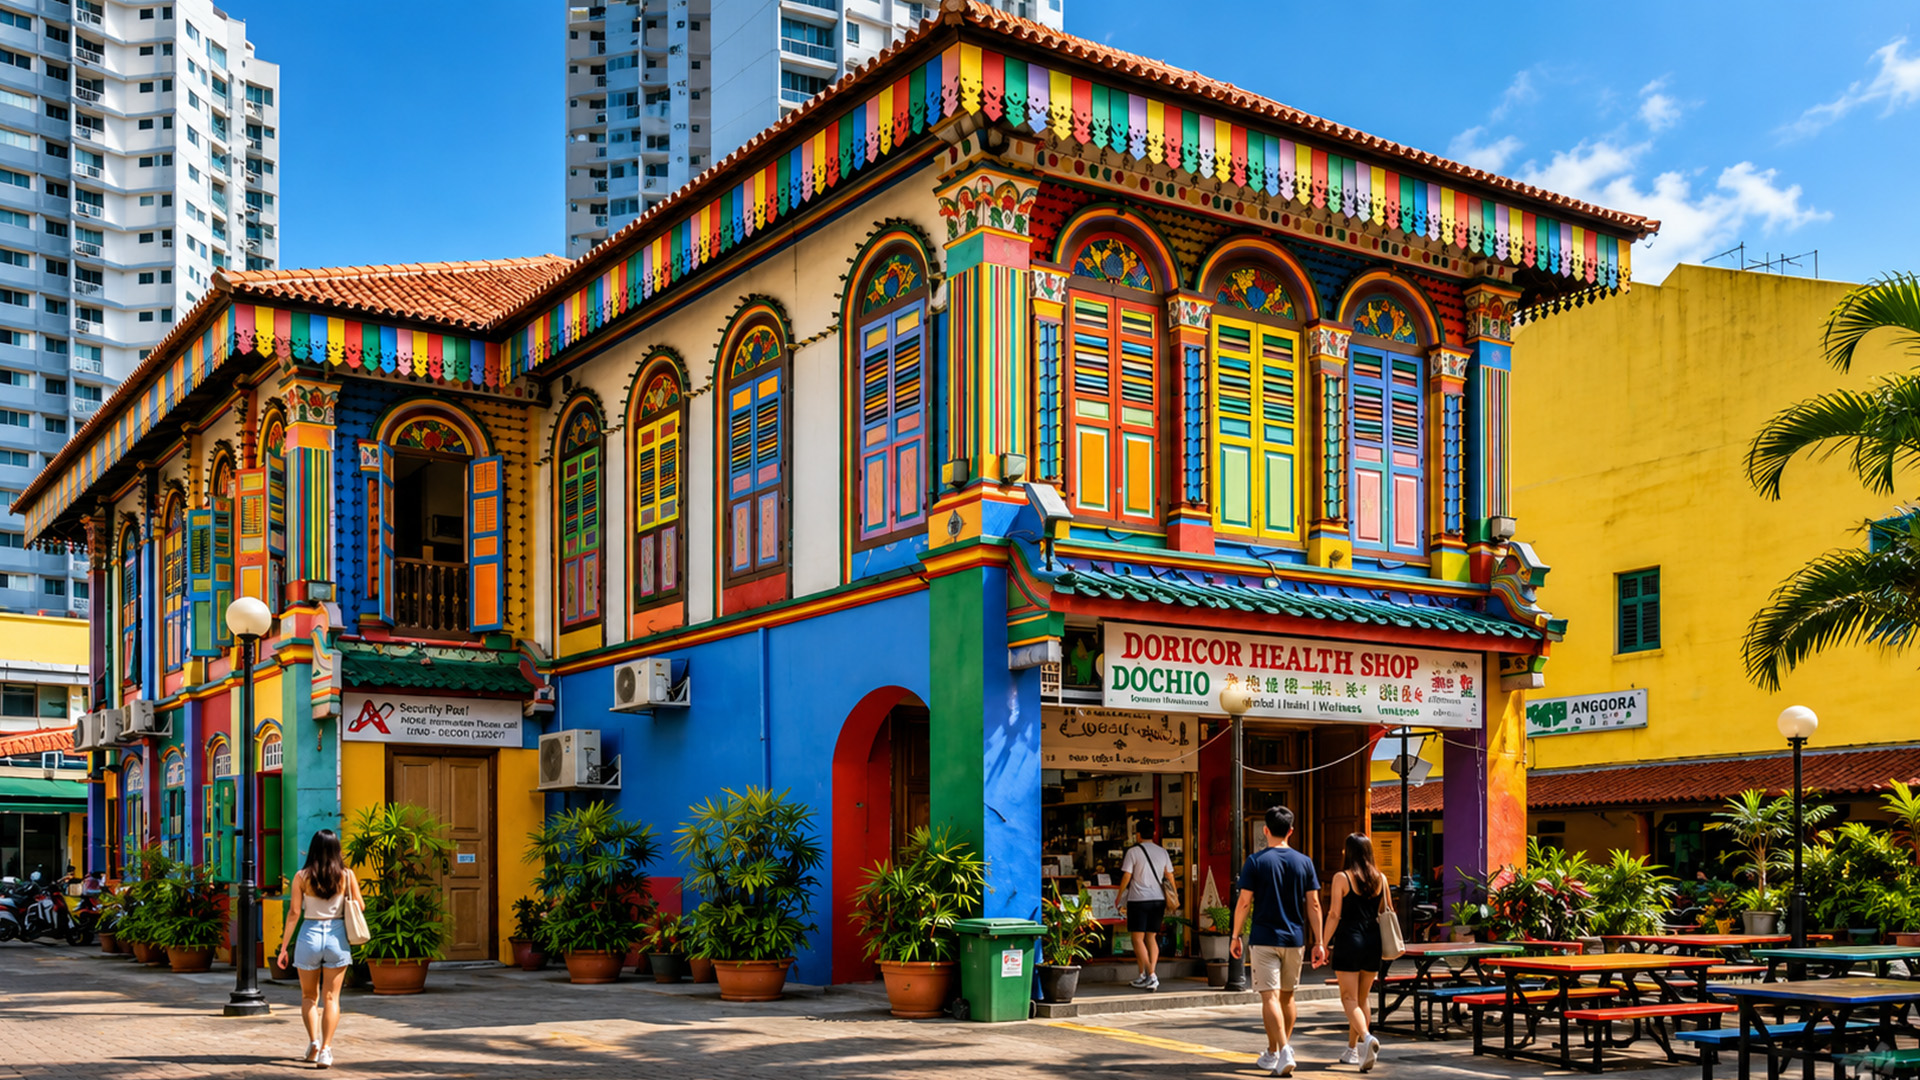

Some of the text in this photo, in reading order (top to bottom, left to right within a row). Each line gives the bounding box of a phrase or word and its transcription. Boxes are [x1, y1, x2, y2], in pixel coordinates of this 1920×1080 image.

[1121, 631, 1420, 679] DORICOR HEALTH SHOP
[1112, 665, 1210, 695] DOCHIO
[1571, 695, 1637, 714] ANGOORA
